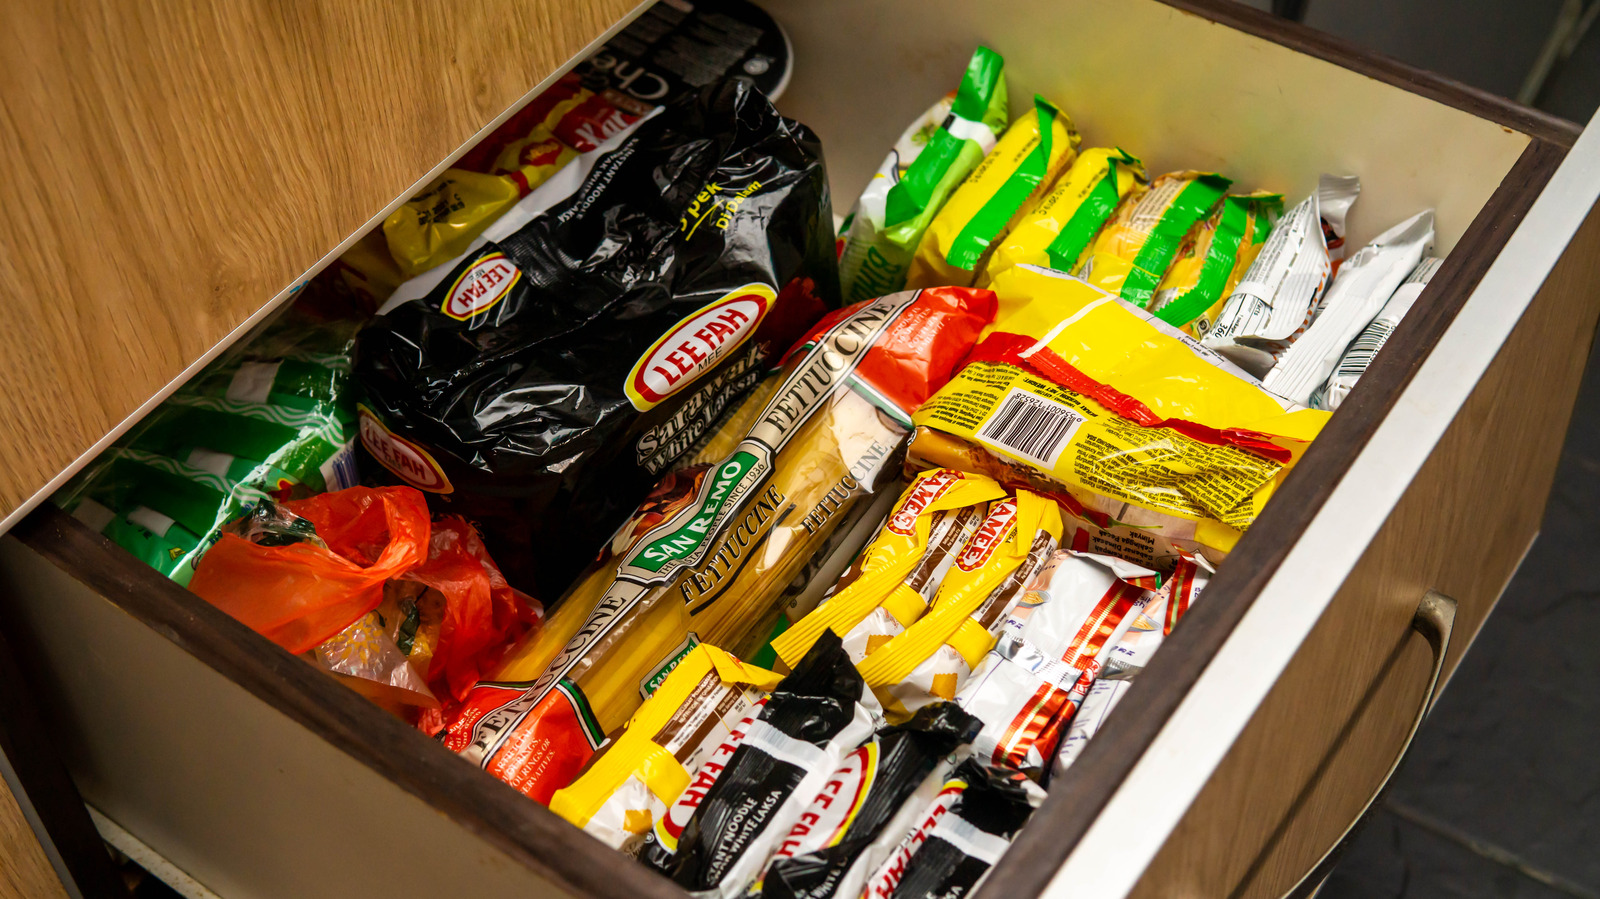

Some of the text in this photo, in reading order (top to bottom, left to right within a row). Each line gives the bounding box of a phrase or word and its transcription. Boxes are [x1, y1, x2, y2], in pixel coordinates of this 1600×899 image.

[458, 264, 511, 308] LEE FAH
[653, 308, 749, 386] LEE FAH
[698, 346, 723, 372] MEE
[763, 299, 896, 435] FETTUCCINE
[637, 343, 769, 465] Sarawak
[645, 370, 759, 475] White Laksa
[1017, 393, 1041, 406] 126528
[1047, 404, 1073, 418] 556001
[365, 427, 426, 480] LEE FAH
[643, 461, 742, 562] SAN REMO
[802, 440, 890, 536] FETTUCCINE
[657, 560, 677, 577] THE
[726, 482, 748, 511] SINCE
[745, 462, 766, 484] 1936
[679, 484, 785, 606] FETTUCCINE
[964, 500, 1018, 561] AMEE
[1092, 536, 1151, 559] Sebenar Dimasak
[1099, 530, 1151, 551] Sehingga Pecah
[1130, 530, 1153, 543] Minyak
[476, 595, 627, 751] FETTUCCINE
[649, 669, 669, 695] SAN
[725, 796, 757, 841] NOODLE
[730, 789, 783, 855] WHITE LAKSA
